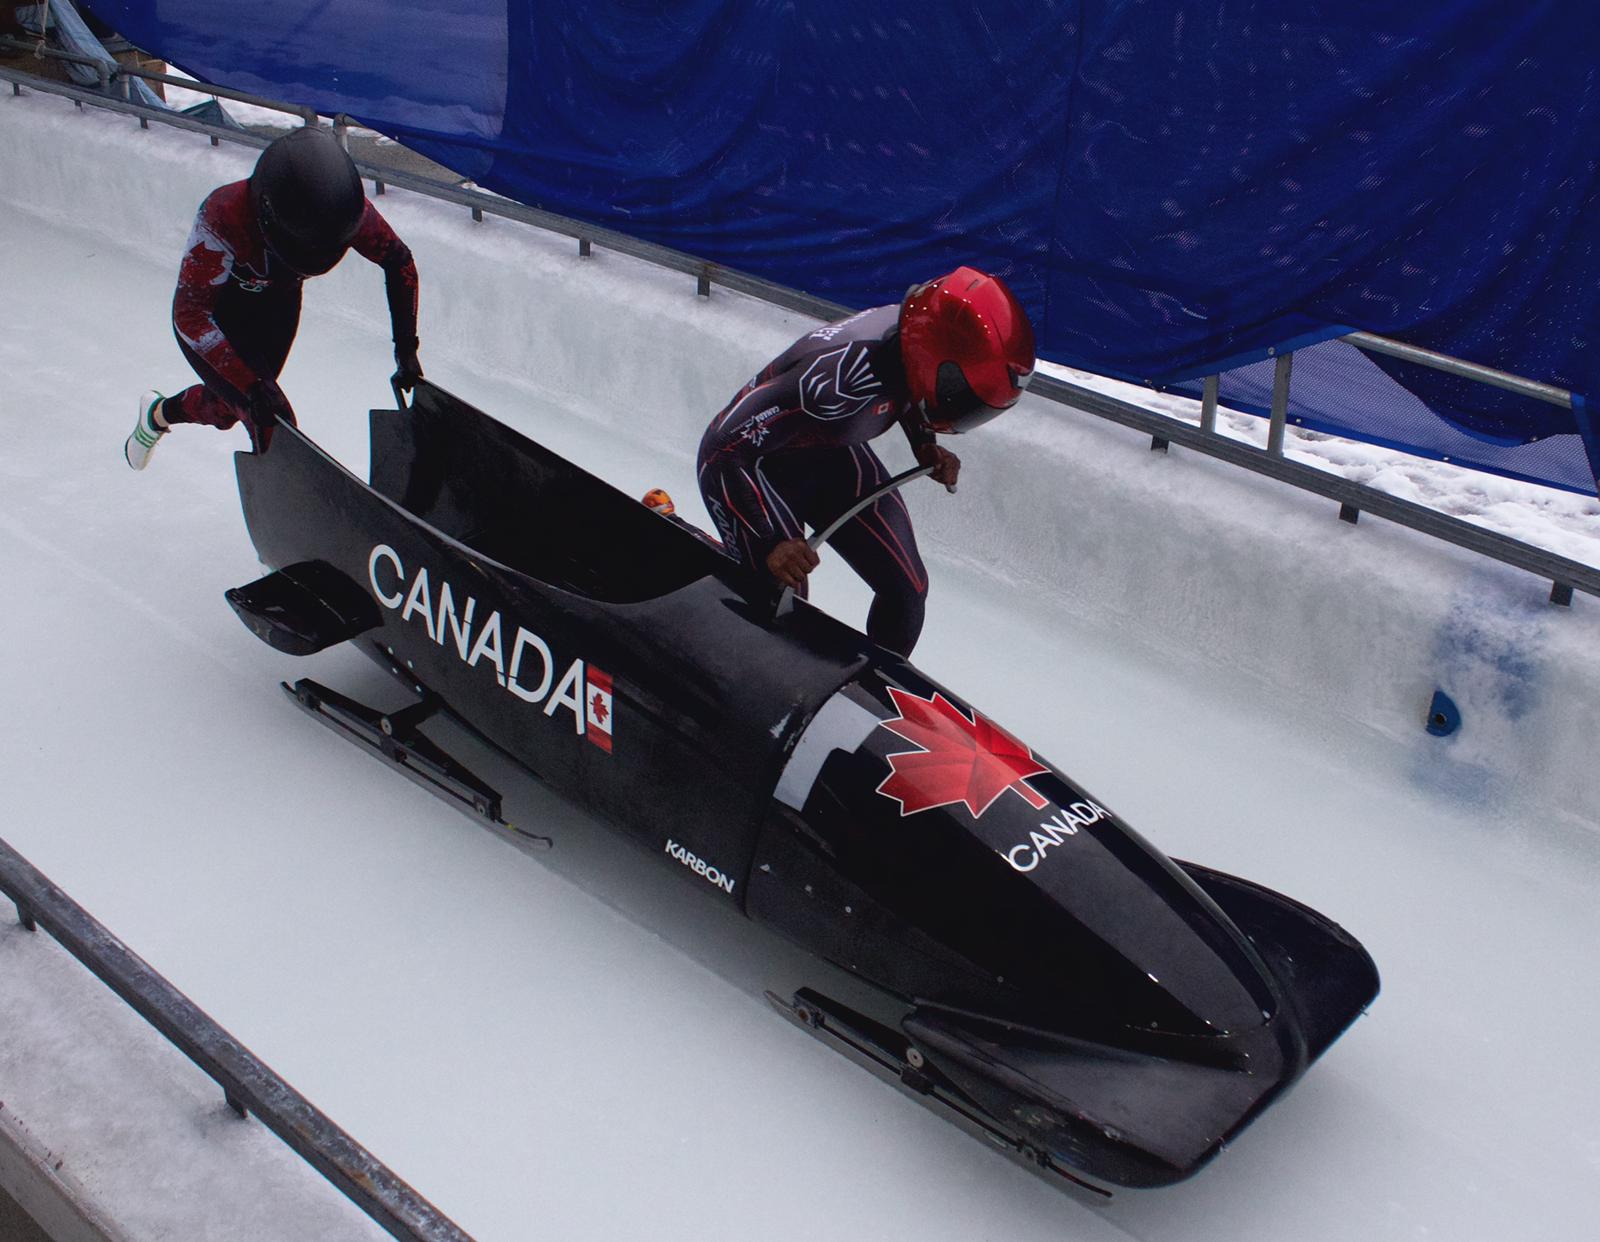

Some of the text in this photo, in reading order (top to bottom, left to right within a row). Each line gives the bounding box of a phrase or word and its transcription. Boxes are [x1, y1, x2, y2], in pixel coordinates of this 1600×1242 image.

[368, 543, 586, 736] CANADA
[664, 838, 735, 894] KARBON
[1008, 798, 1113, 872] CANADA
